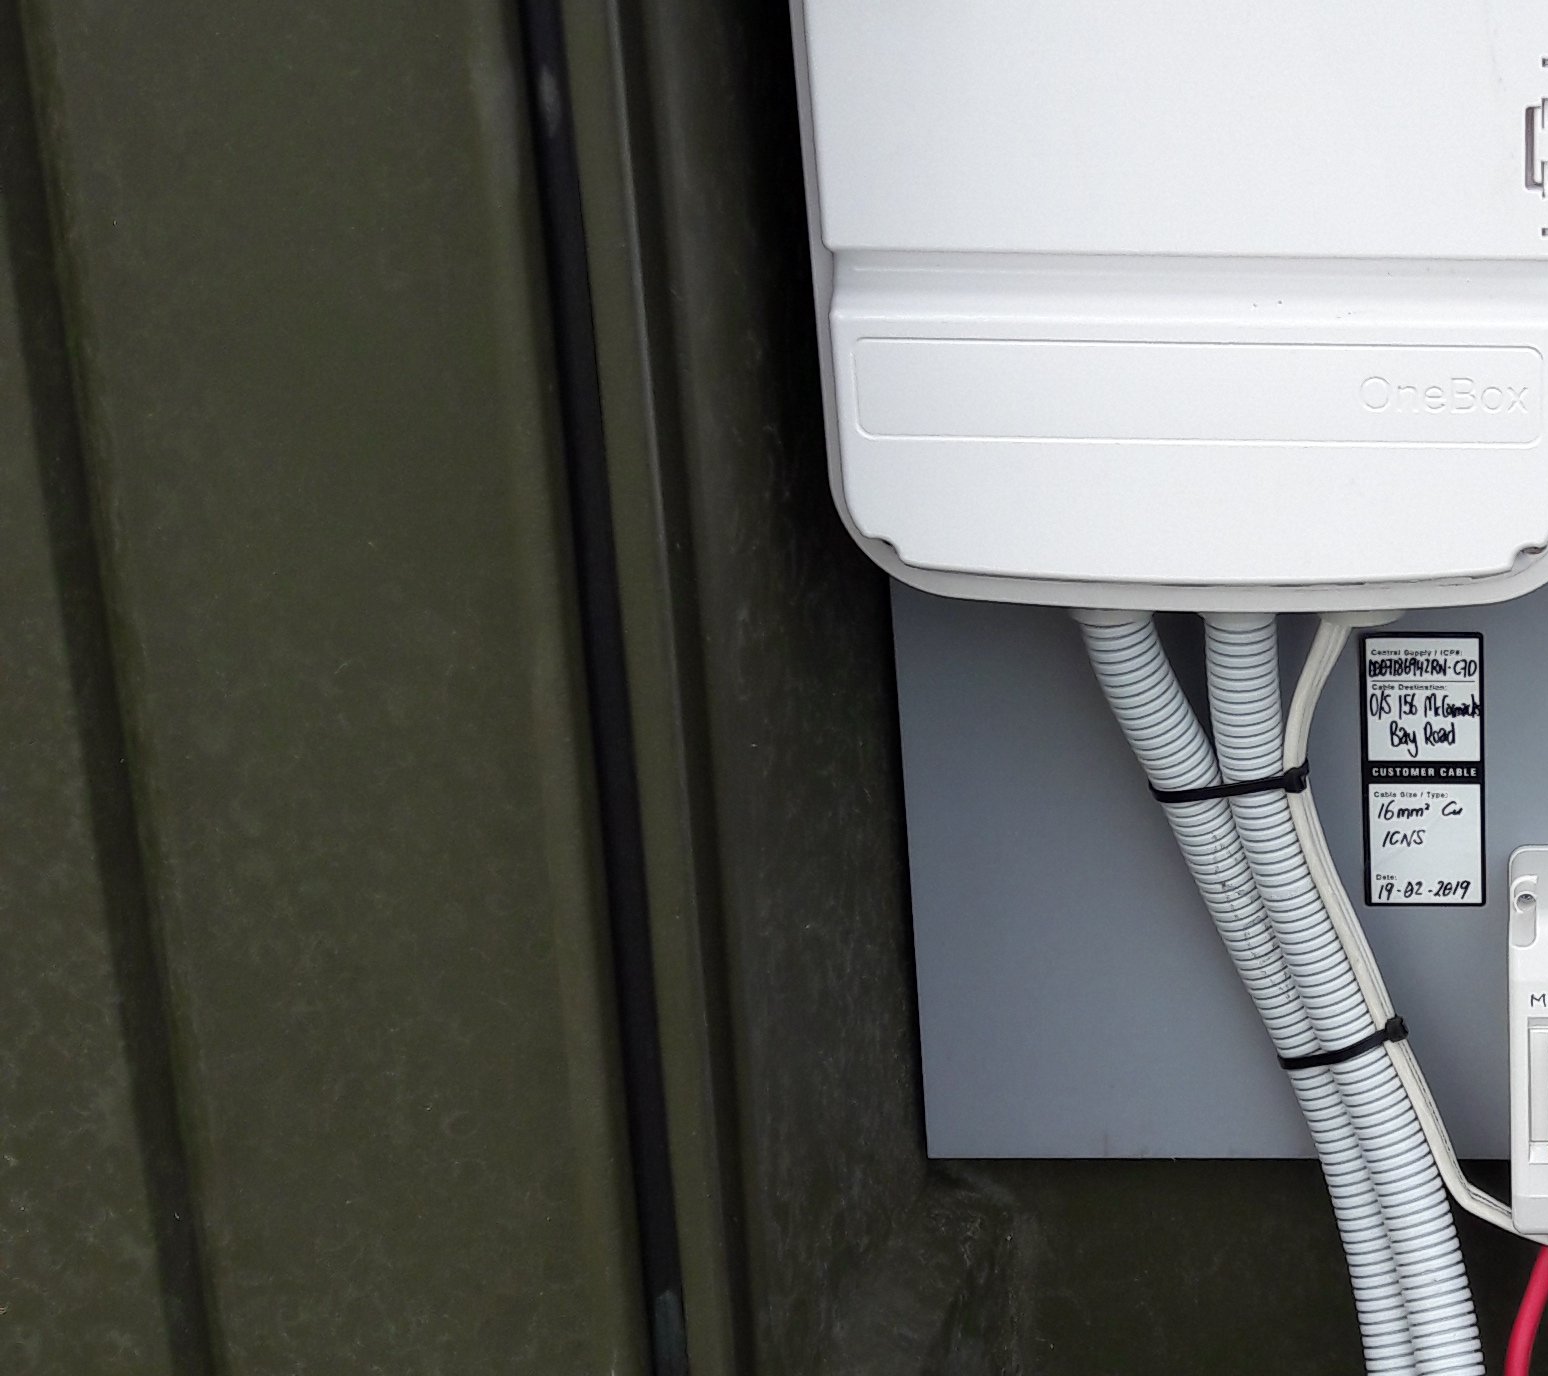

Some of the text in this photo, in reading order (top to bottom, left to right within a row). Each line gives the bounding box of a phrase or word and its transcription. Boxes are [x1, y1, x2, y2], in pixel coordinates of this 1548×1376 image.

[1360, 375, 1529, 414] OneBox
[1398, 692, 1418, 720] 156
[1389, 720, 1456, 758] Bay Road
[1372, 767, 1477, 777] CUSTOMER CABLE
